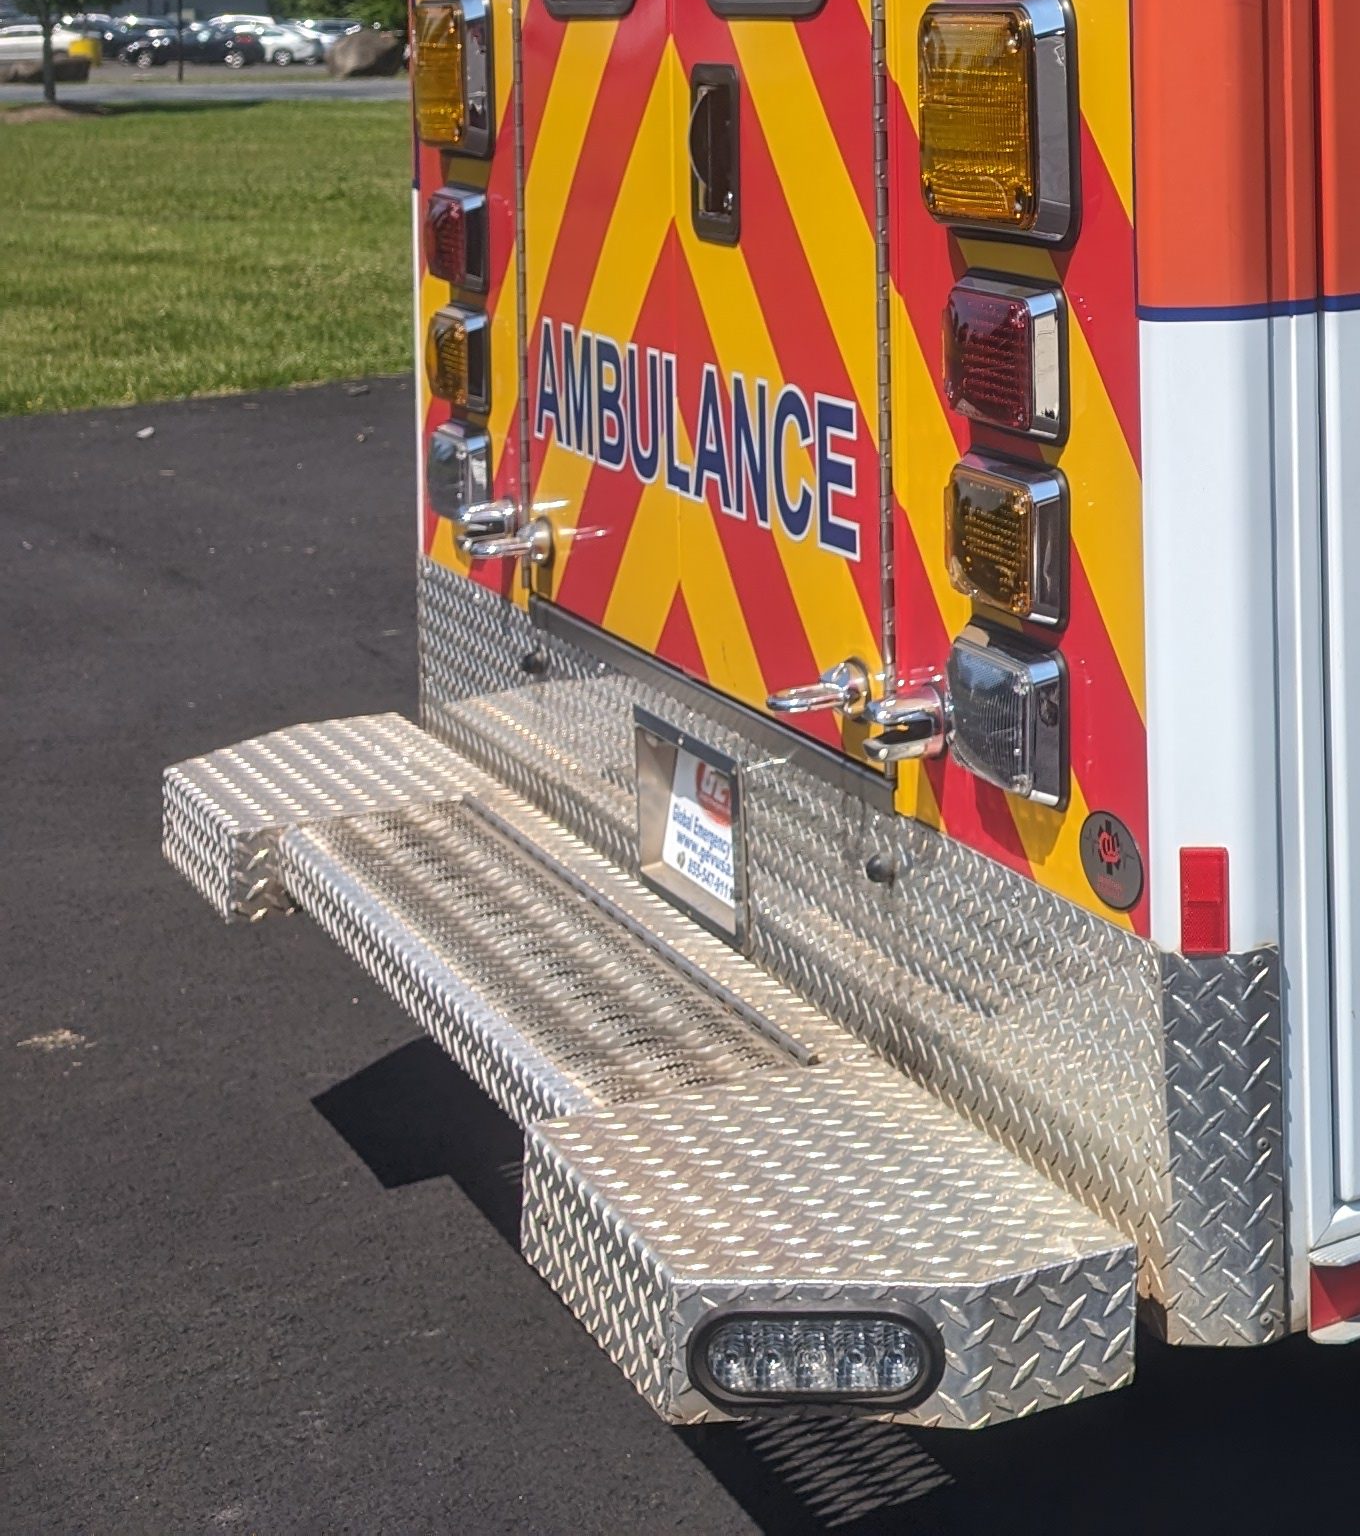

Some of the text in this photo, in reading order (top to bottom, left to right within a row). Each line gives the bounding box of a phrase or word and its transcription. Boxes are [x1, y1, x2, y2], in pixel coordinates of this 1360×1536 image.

[533, 316, 861, 562] AMBULANCE
[672, 802, 693, 833] Global
[693, 816, 730, 861] Emergency
